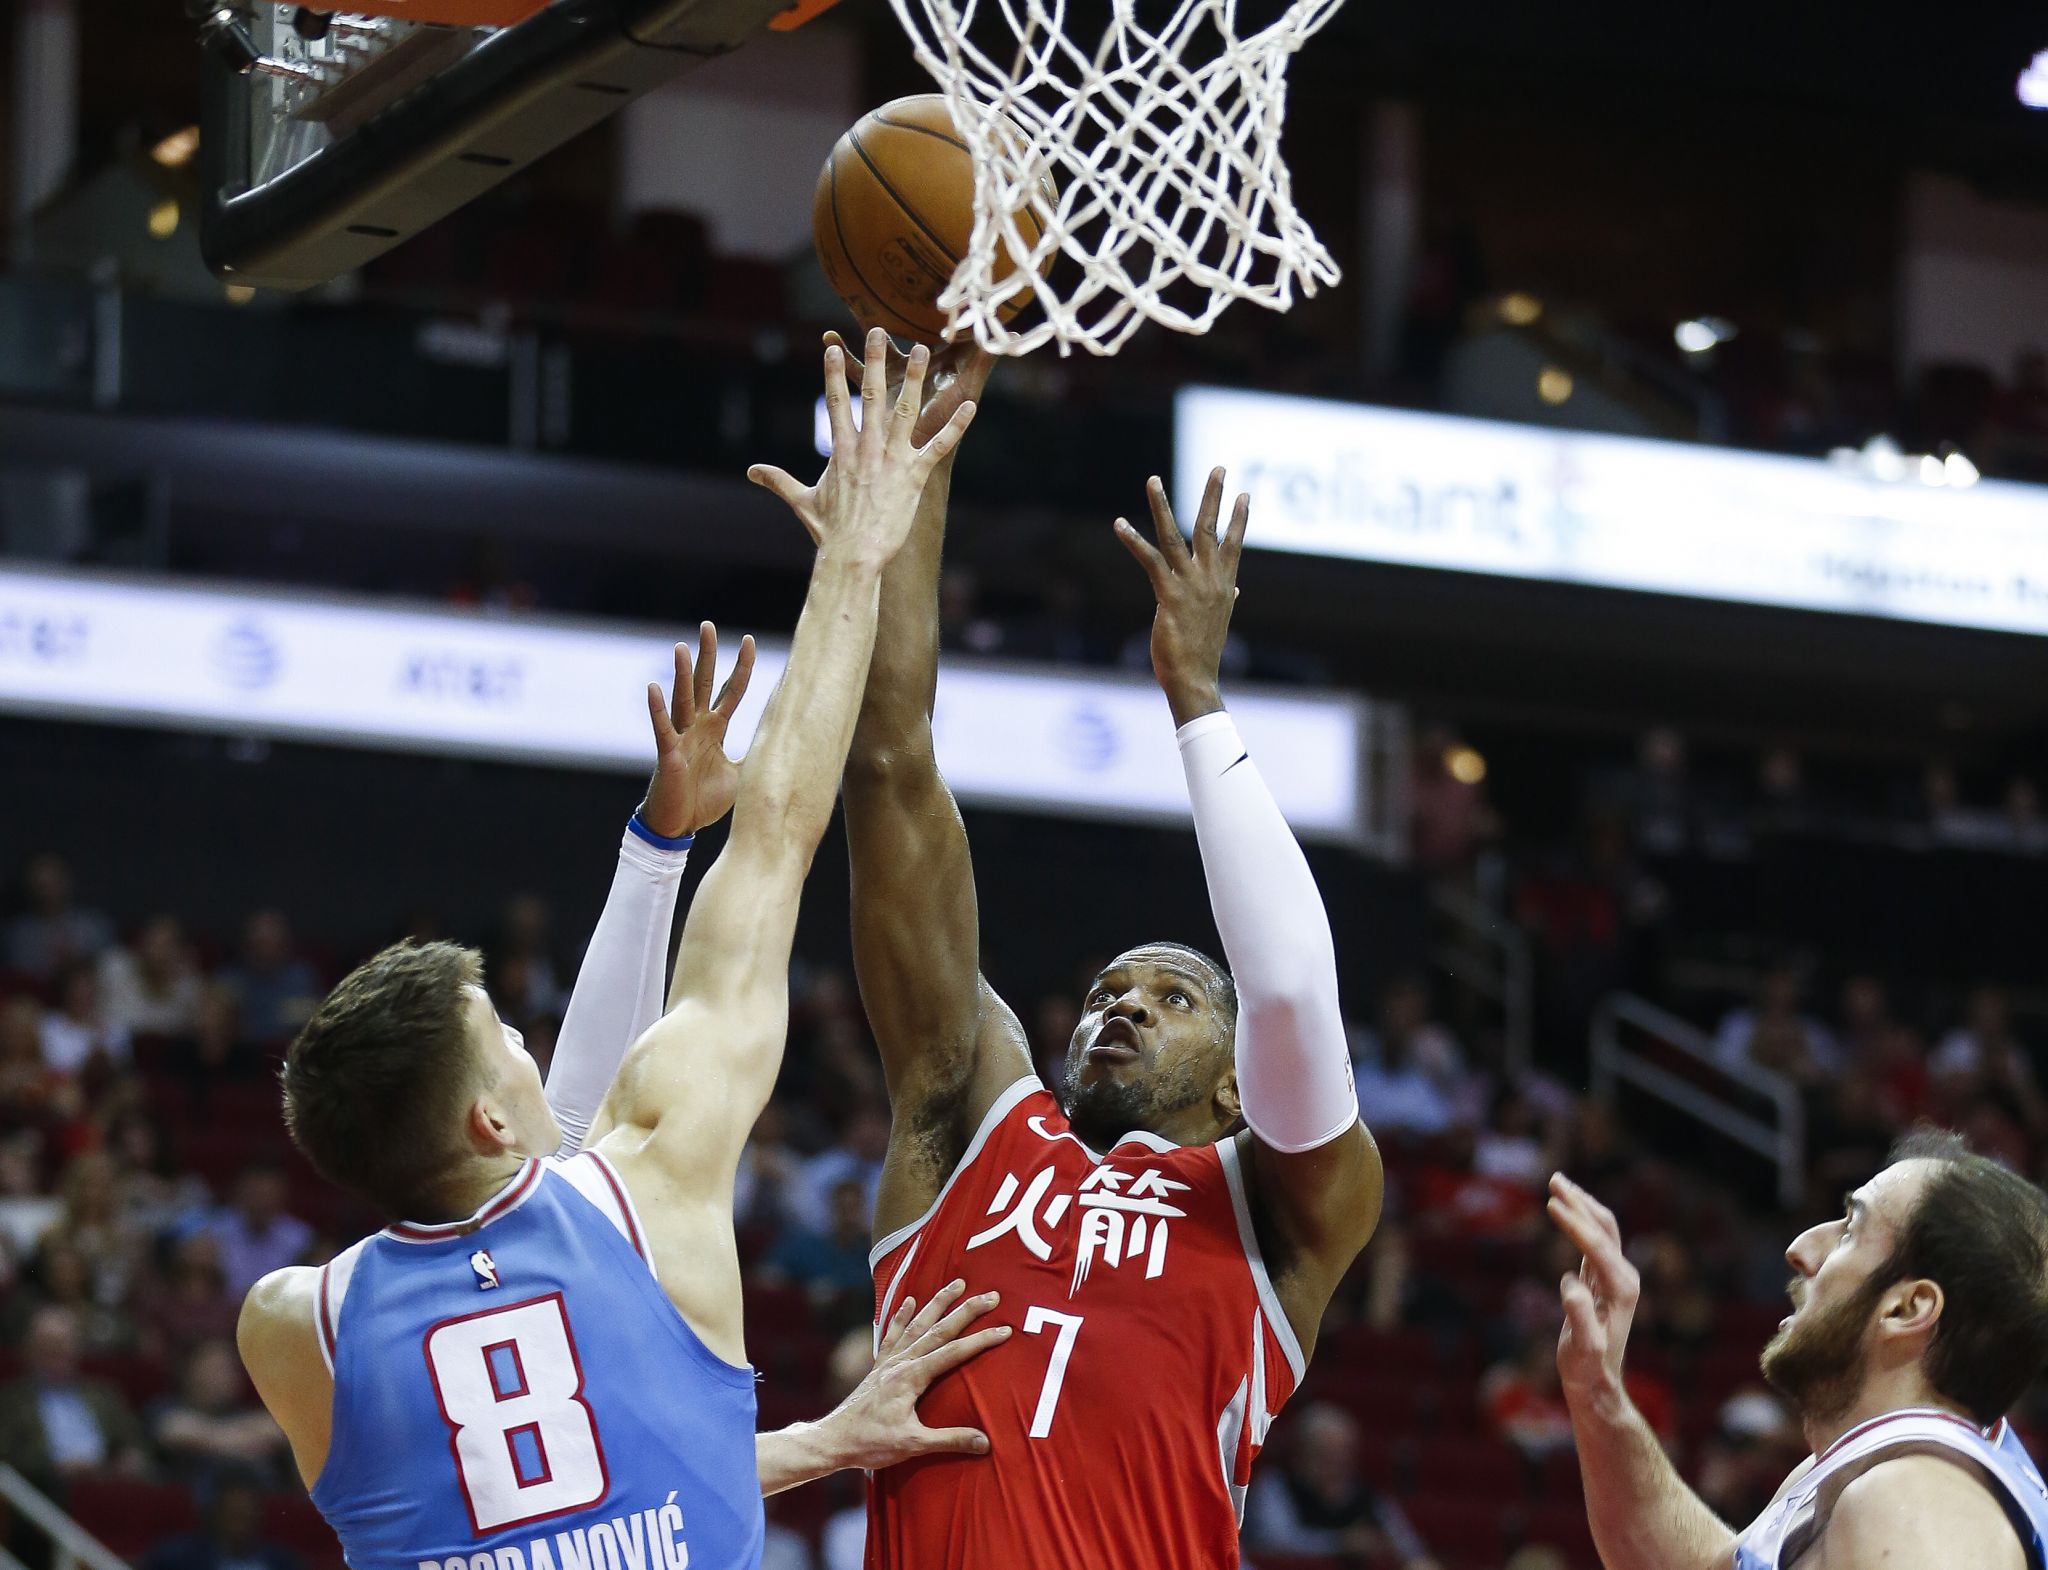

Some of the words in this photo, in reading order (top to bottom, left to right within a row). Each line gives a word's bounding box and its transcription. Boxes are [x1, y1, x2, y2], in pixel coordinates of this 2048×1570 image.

[1238, 450, 1522, 544] reliant
[422, 1290, 610, 1538] 8
[1023, 1305, 1084, 1438] 7
